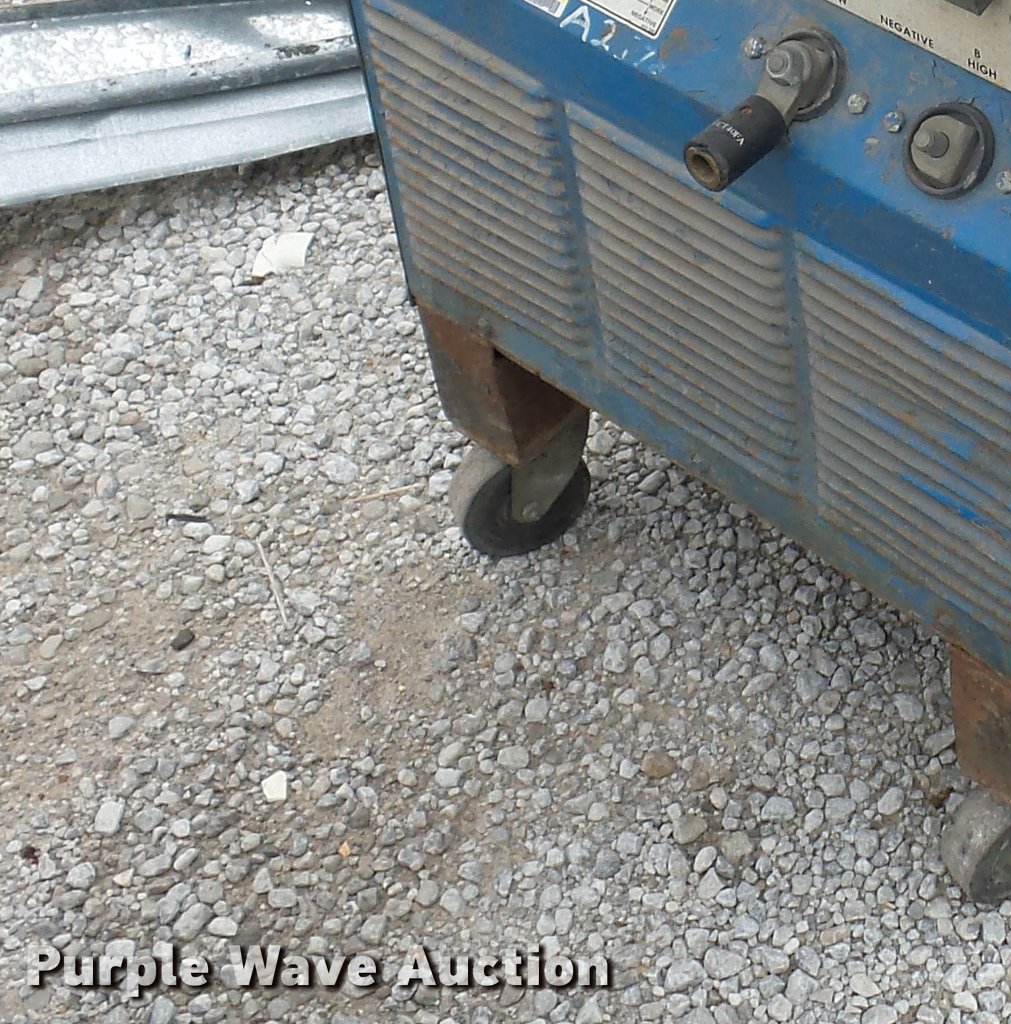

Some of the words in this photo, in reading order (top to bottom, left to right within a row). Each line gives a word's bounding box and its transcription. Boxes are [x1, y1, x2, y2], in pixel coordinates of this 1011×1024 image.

[631, 10, 657, 27] NEGATIVE
[880, 14, 935, 49] NEGATIVE
[974, 48, 981, 59] B
[967, 58, 997, 80] HIGH
